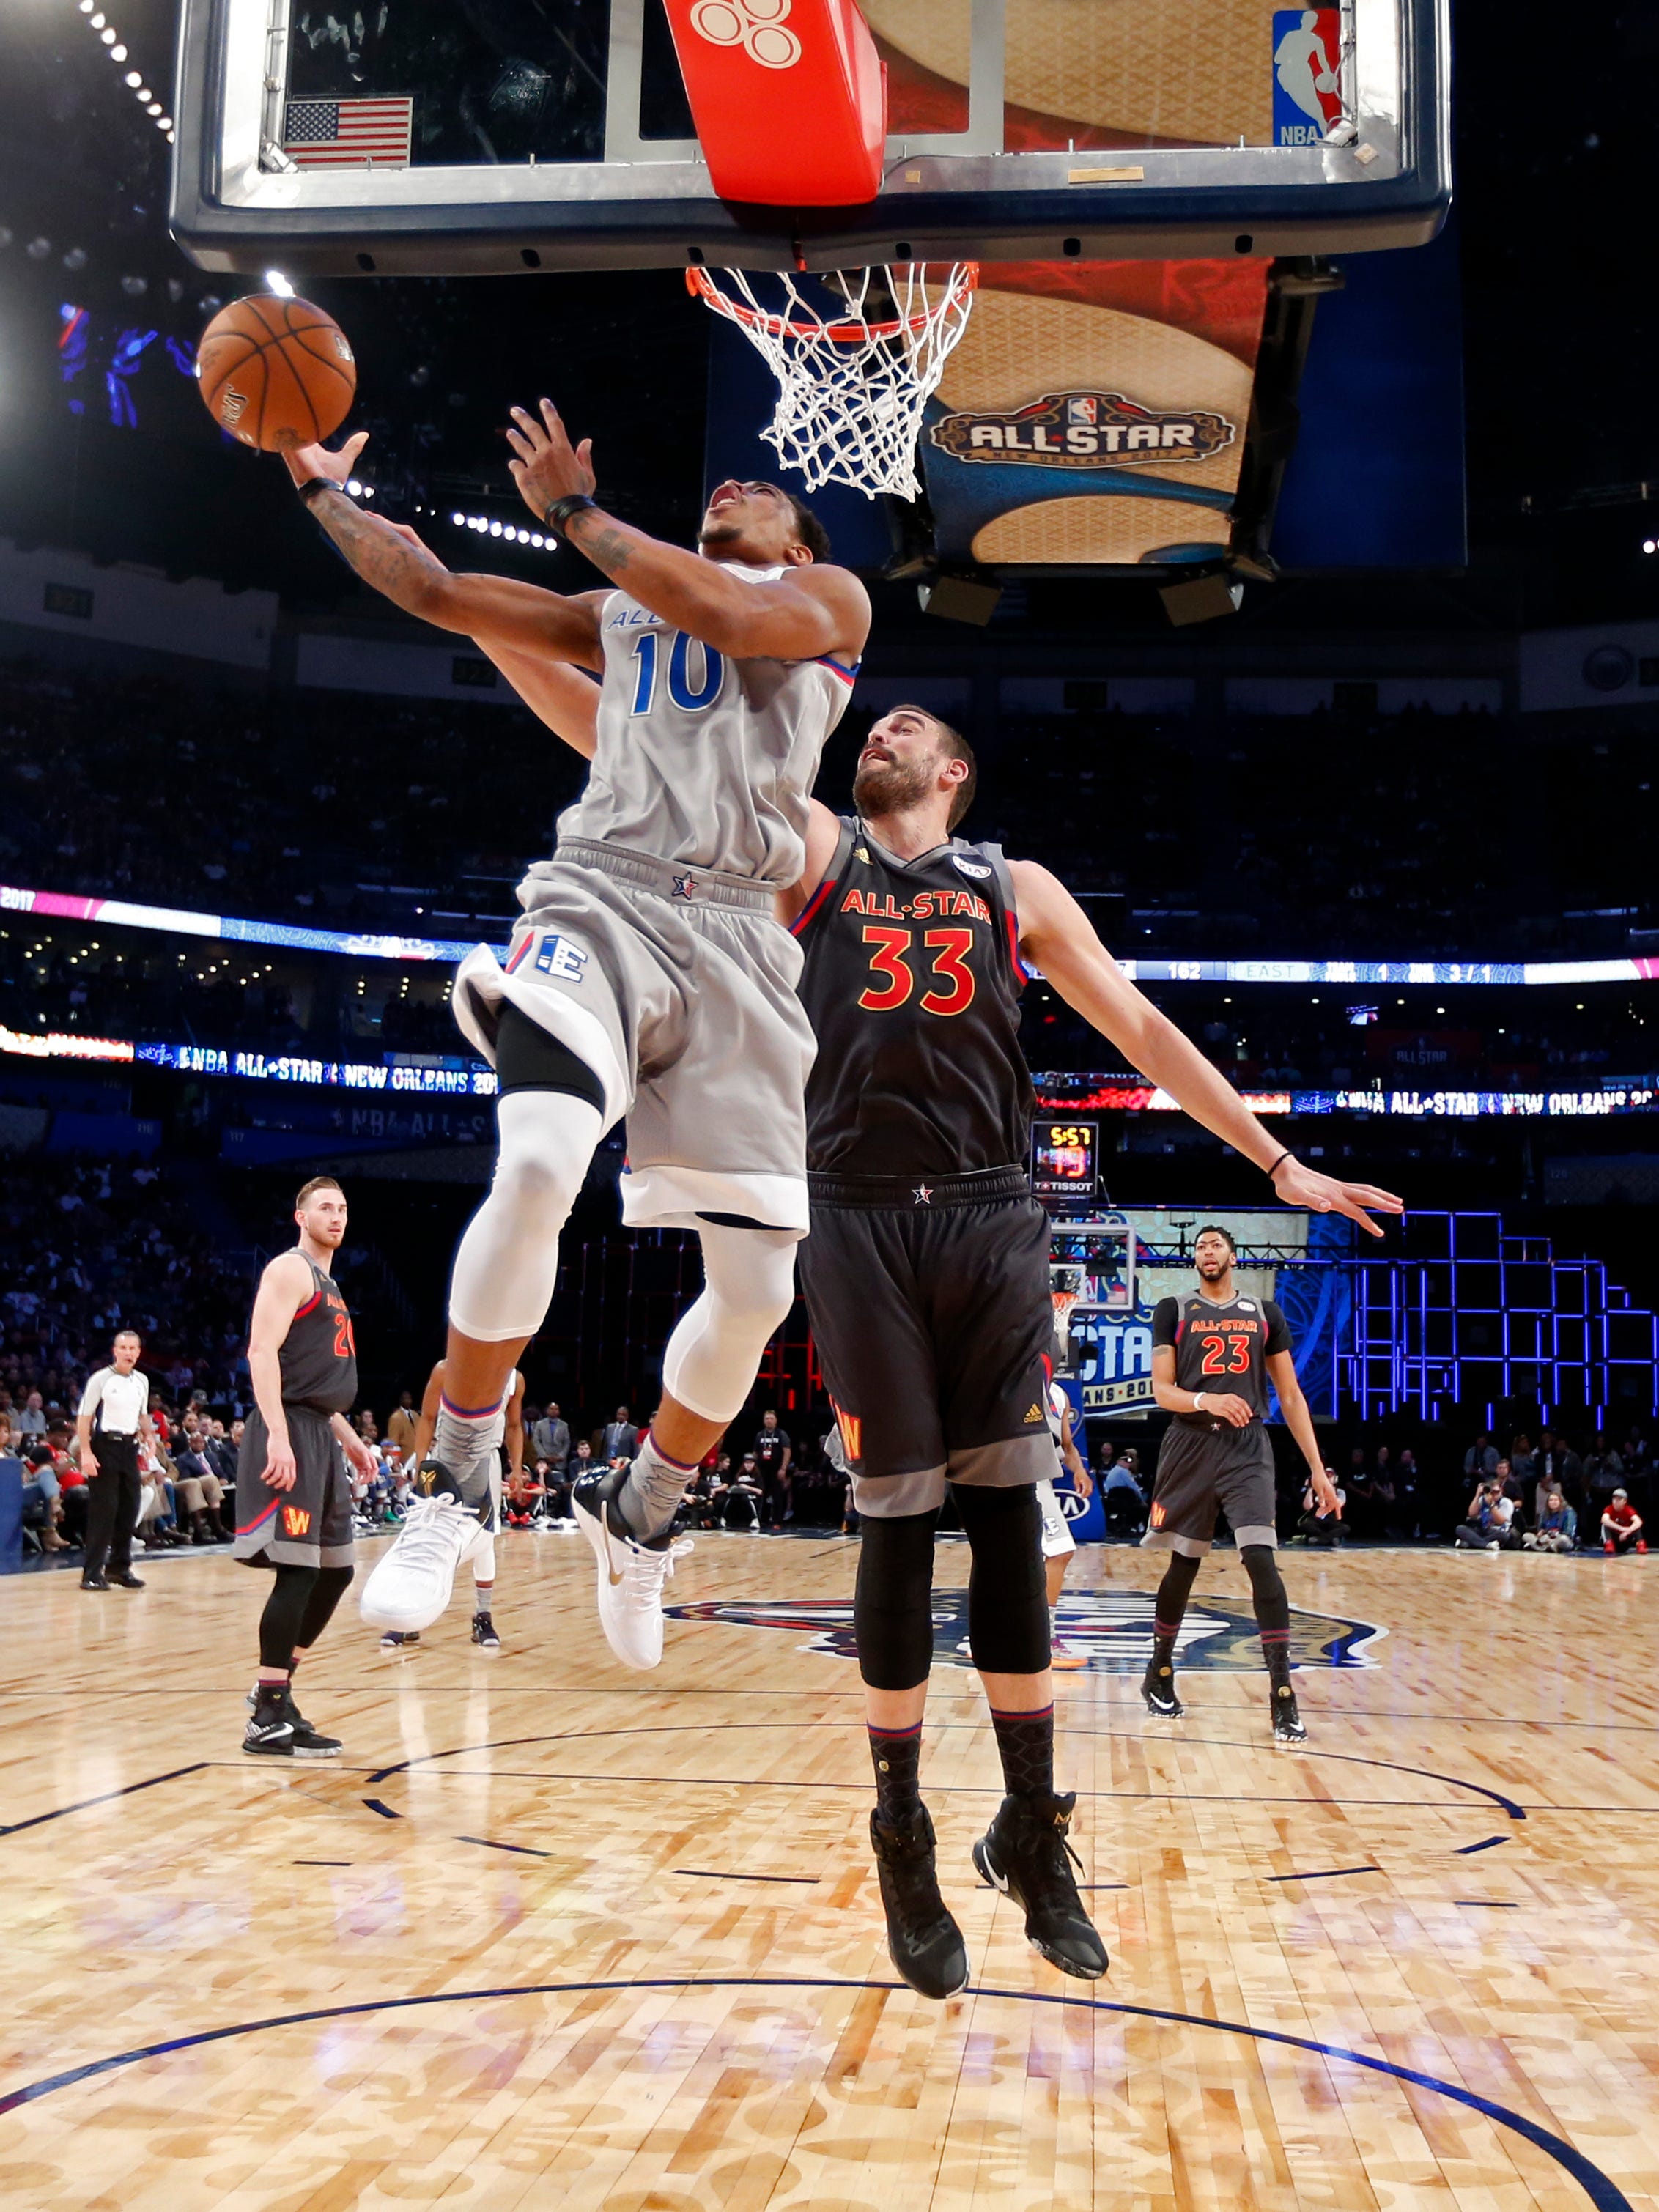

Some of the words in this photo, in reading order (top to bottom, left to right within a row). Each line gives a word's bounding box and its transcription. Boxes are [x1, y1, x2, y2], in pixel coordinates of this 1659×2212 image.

[1280, 125, 1320, 146] NBA
[993, 451, 1027, 461] NEW
[1039, 454, 1118, 465] ORLEANS
[1131, 450, 1172, 461] 2017
[629, 629, 724, 717] 10
[0, 886, 36, 912] 2017
[857, 925, 975, 1017] 33
[1168, 961, 1201, 979] 162
[1246, 964, 1296, 979] EAST
[192, 1047, 229, 1073] NBA
[344, 1063, 388, 1089] NEW
[391, 1067, 469, 1093] ORLEANS
[1050, 1126, 1090, 1147] 5:57
[1201, 1334, 1250, 1375] 23
